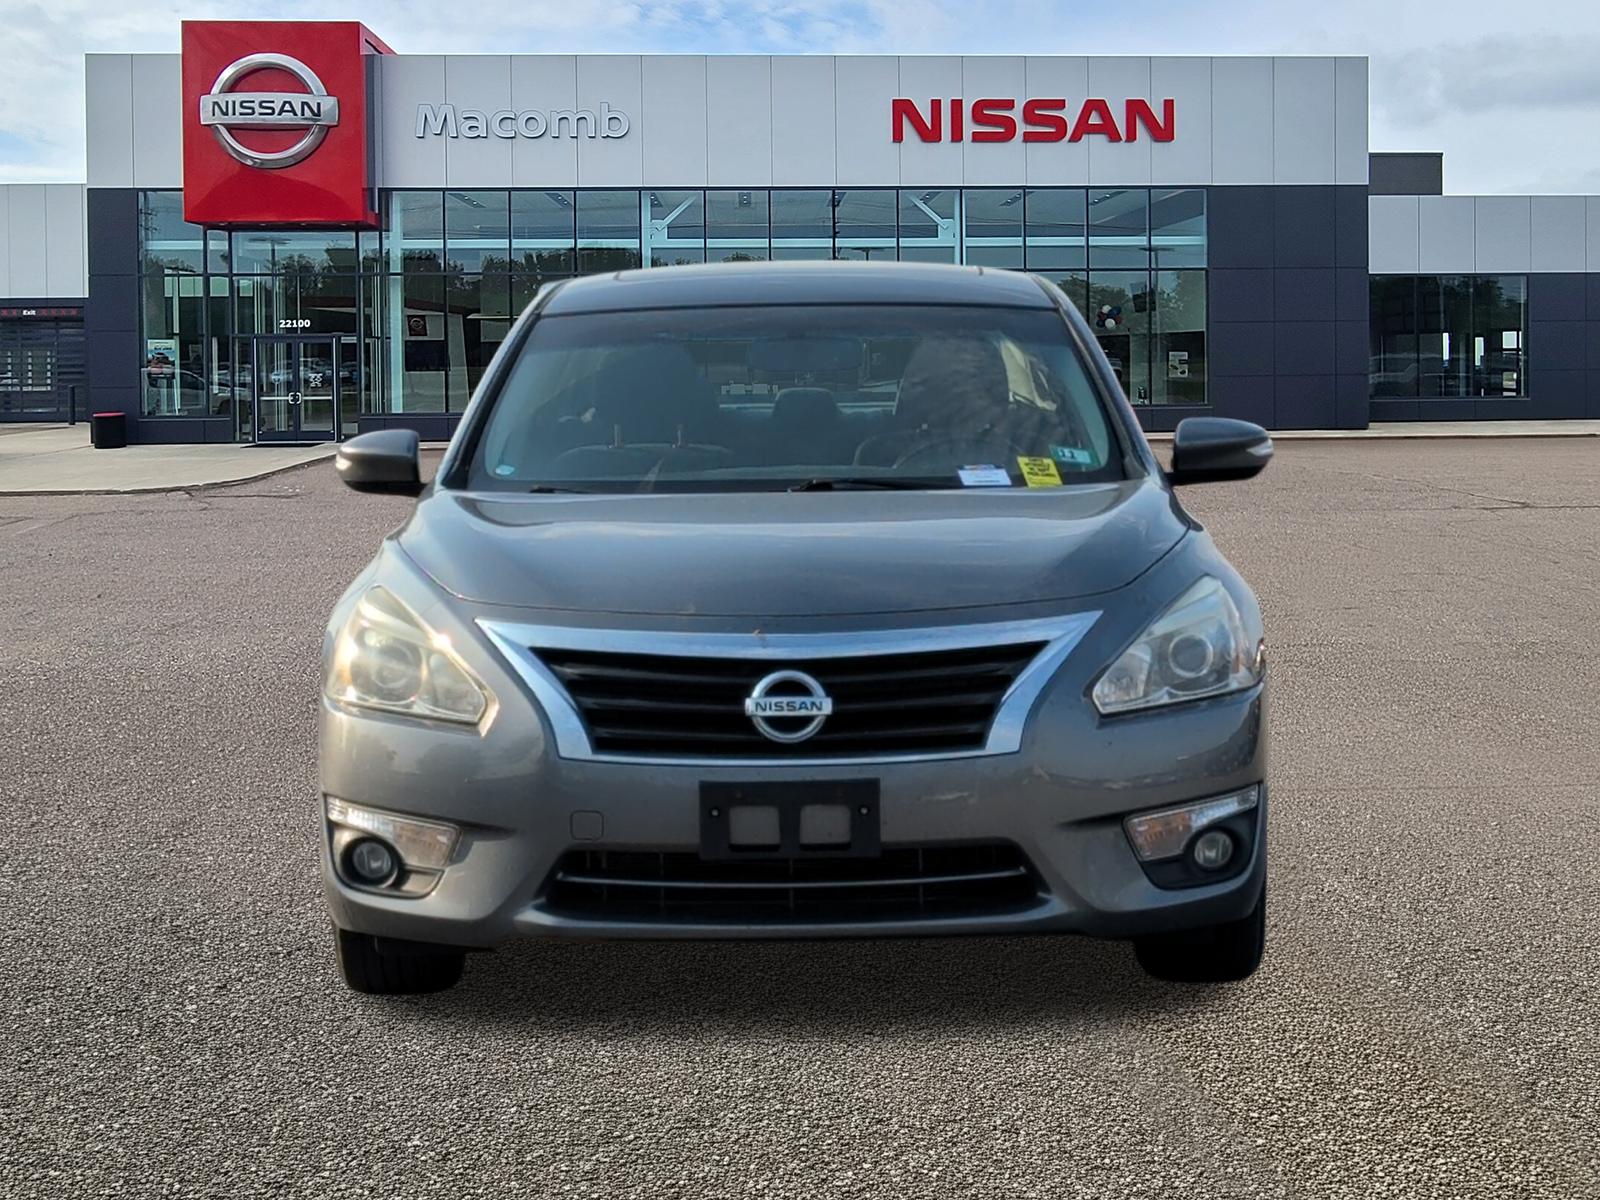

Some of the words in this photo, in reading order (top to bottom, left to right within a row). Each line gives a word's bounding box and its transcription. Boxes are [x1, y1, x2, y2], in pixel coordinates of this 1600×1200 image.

[211, 99, 323, 119] NISSAN
[416, 103, 630, 140] Macomb
[892, 98, 1176, 143] NISSAN
[279, 319, 311, 328] 22100
[755, 700, 823, 713] NISSAN
